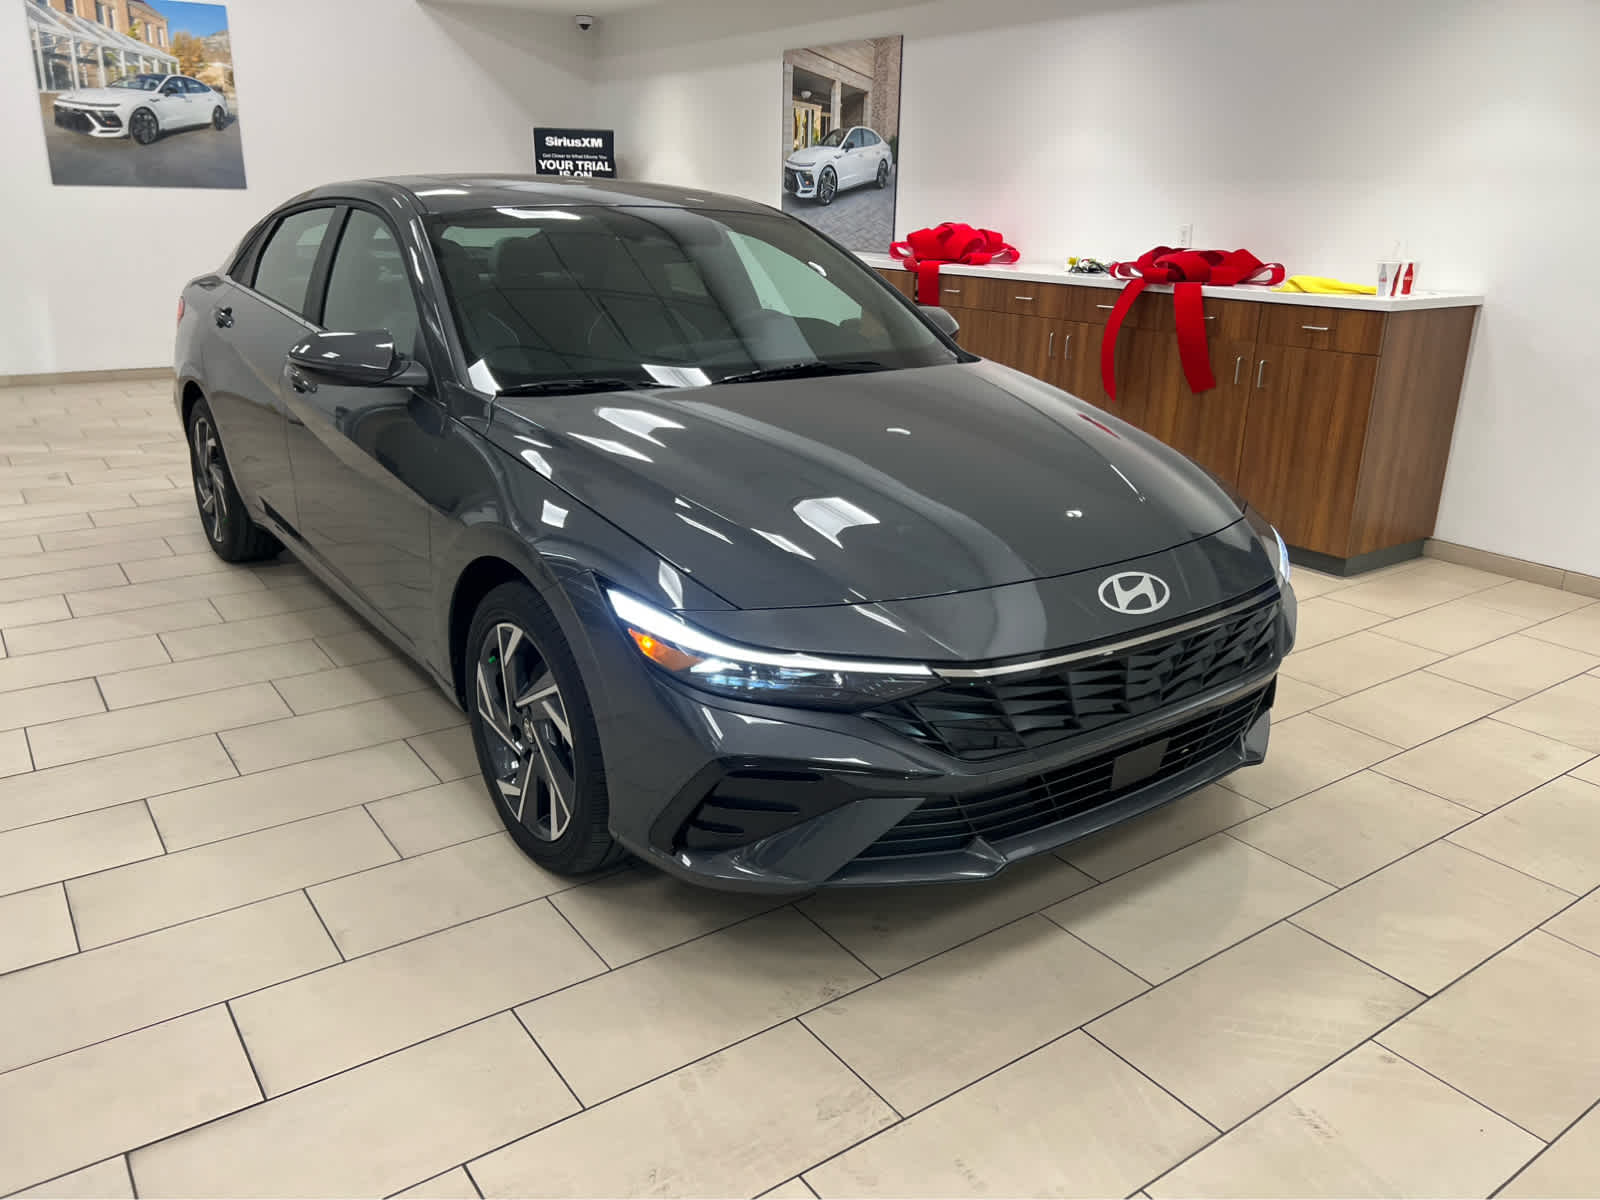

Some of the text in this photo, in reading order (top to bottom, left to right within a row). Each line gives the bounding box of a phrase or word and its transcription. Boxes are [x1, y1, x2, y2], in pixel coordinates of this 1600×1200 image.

[545, 136, 603, 148] SiriusXM
[538, 159, 612, 171] YOUR TRIAL
